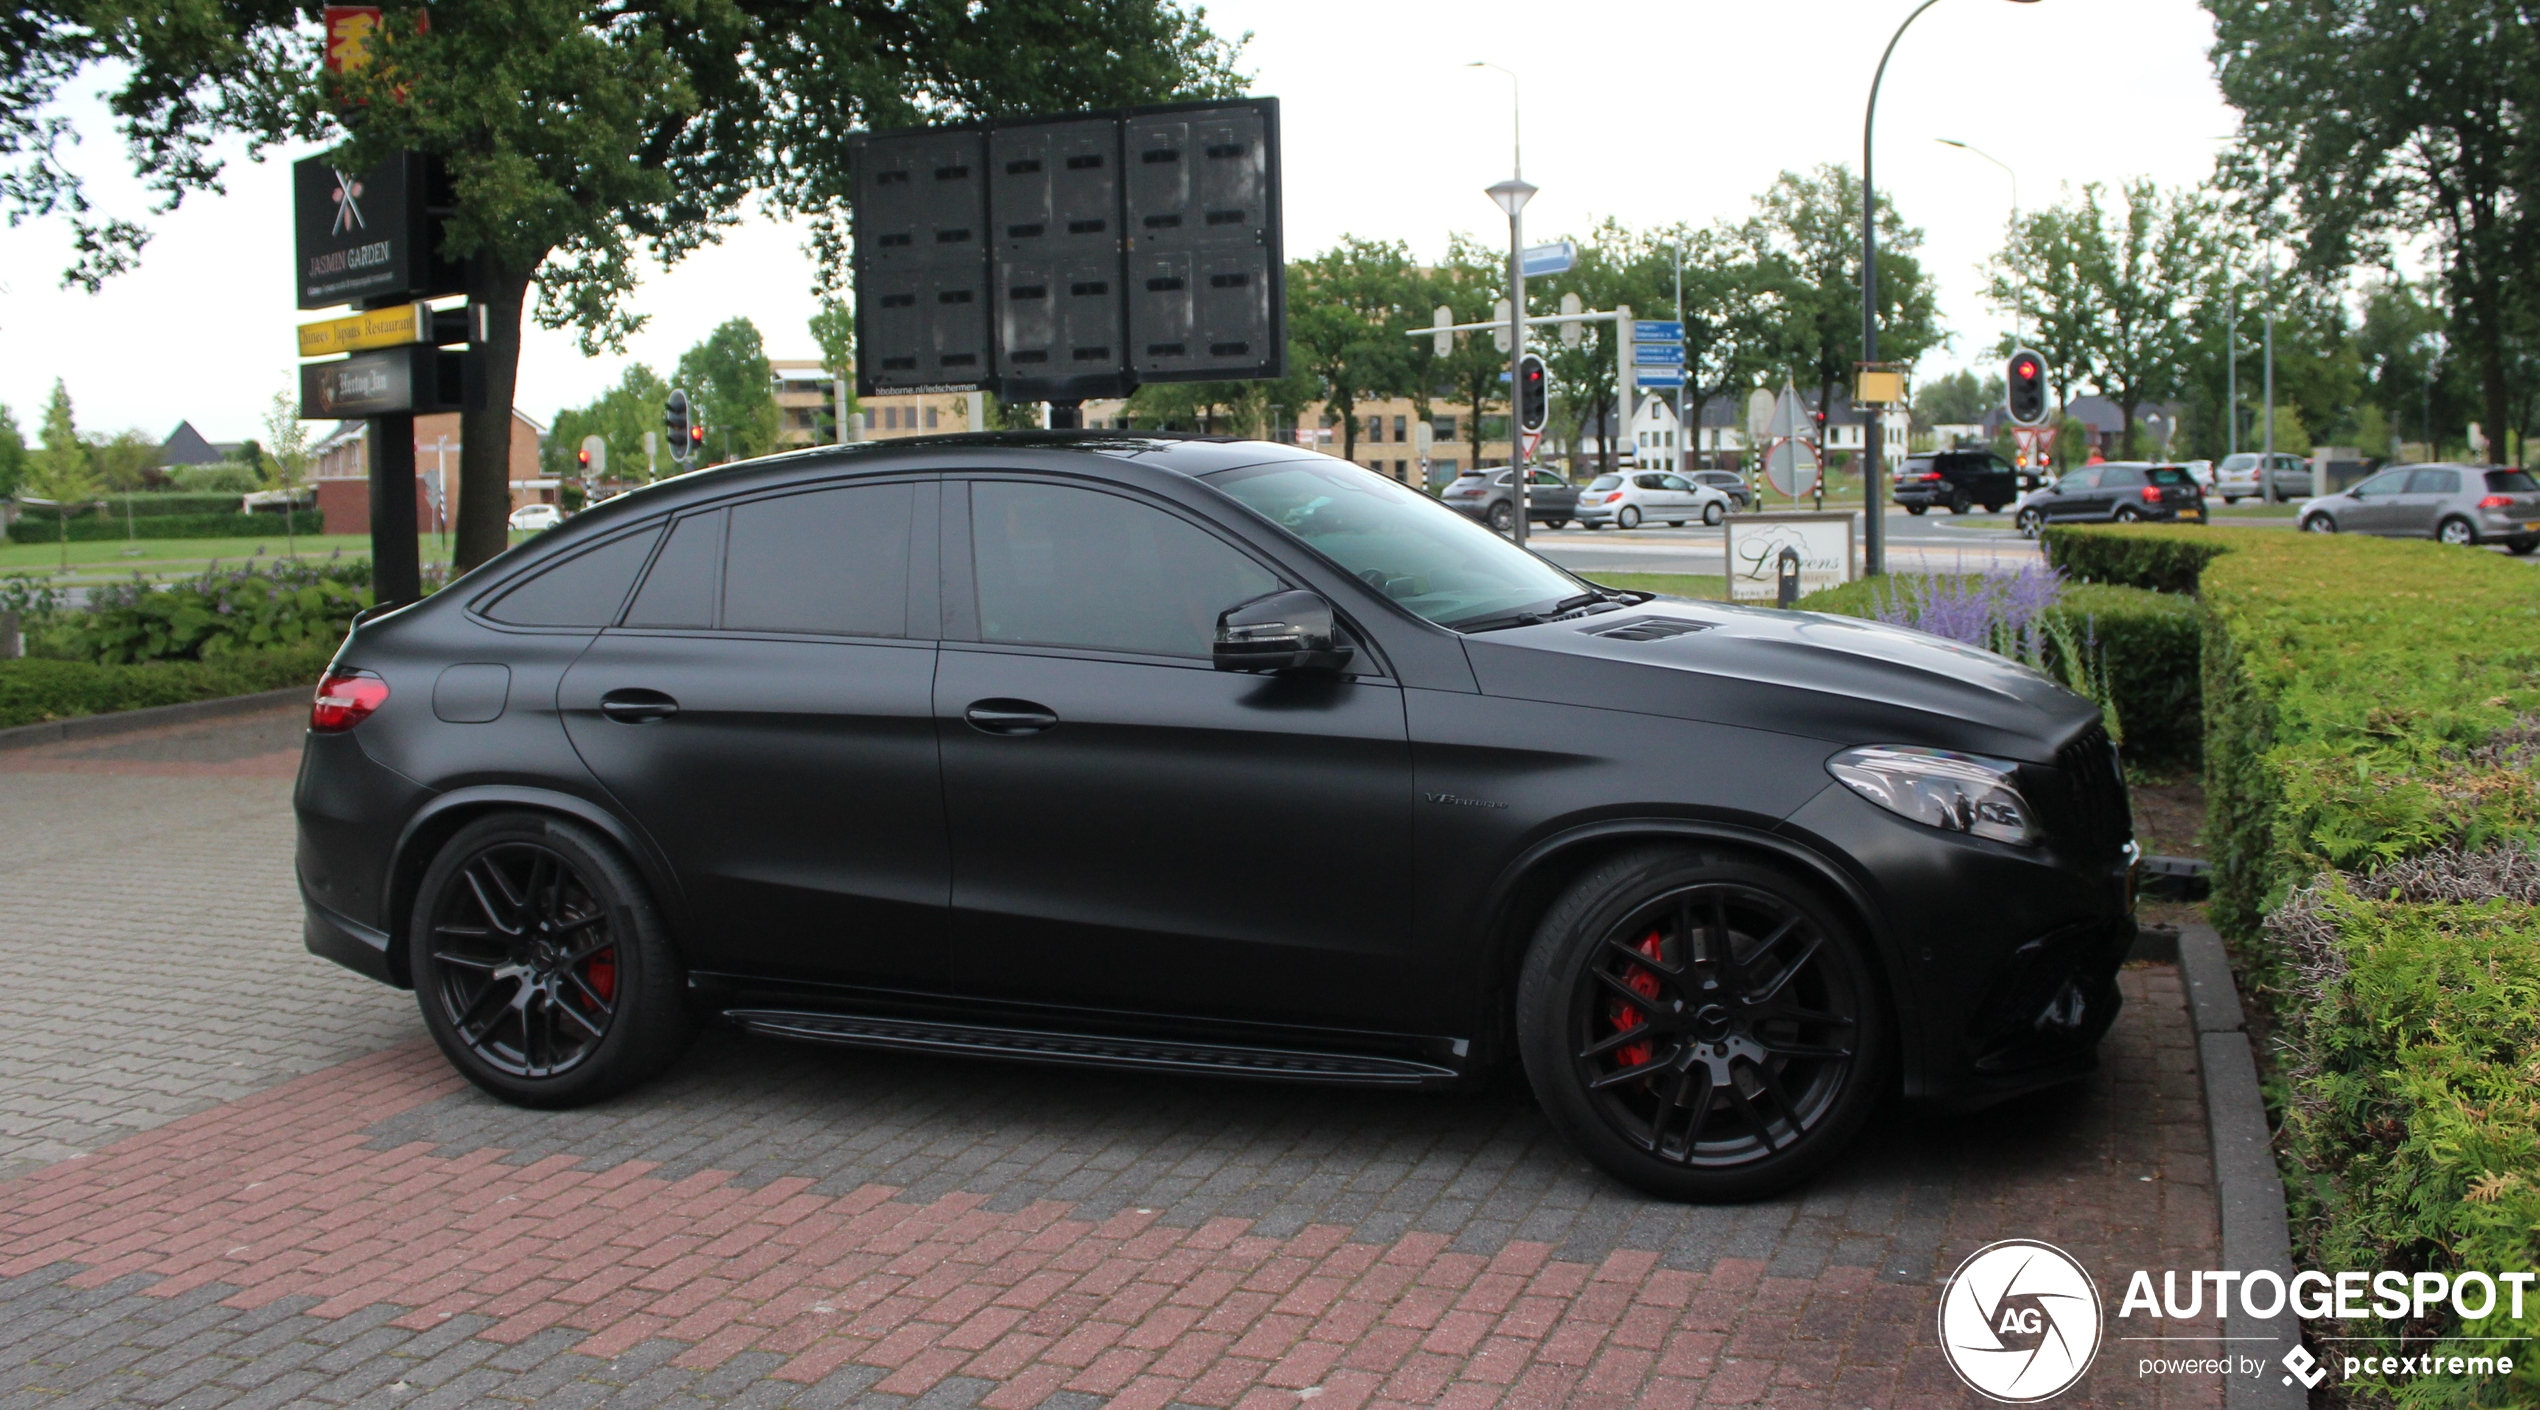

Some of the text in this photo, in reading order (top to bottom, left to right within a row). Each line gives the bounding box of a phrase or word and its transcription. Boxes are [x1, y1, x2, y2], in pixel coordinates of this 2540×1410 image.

[308, 241, 390, 278] JASMIN GARDEN
[333, 324, 360, 346] Japans
[365, 316, 413, 337] Restaurant
[338, 369, 388, 396] Hertog Jan
